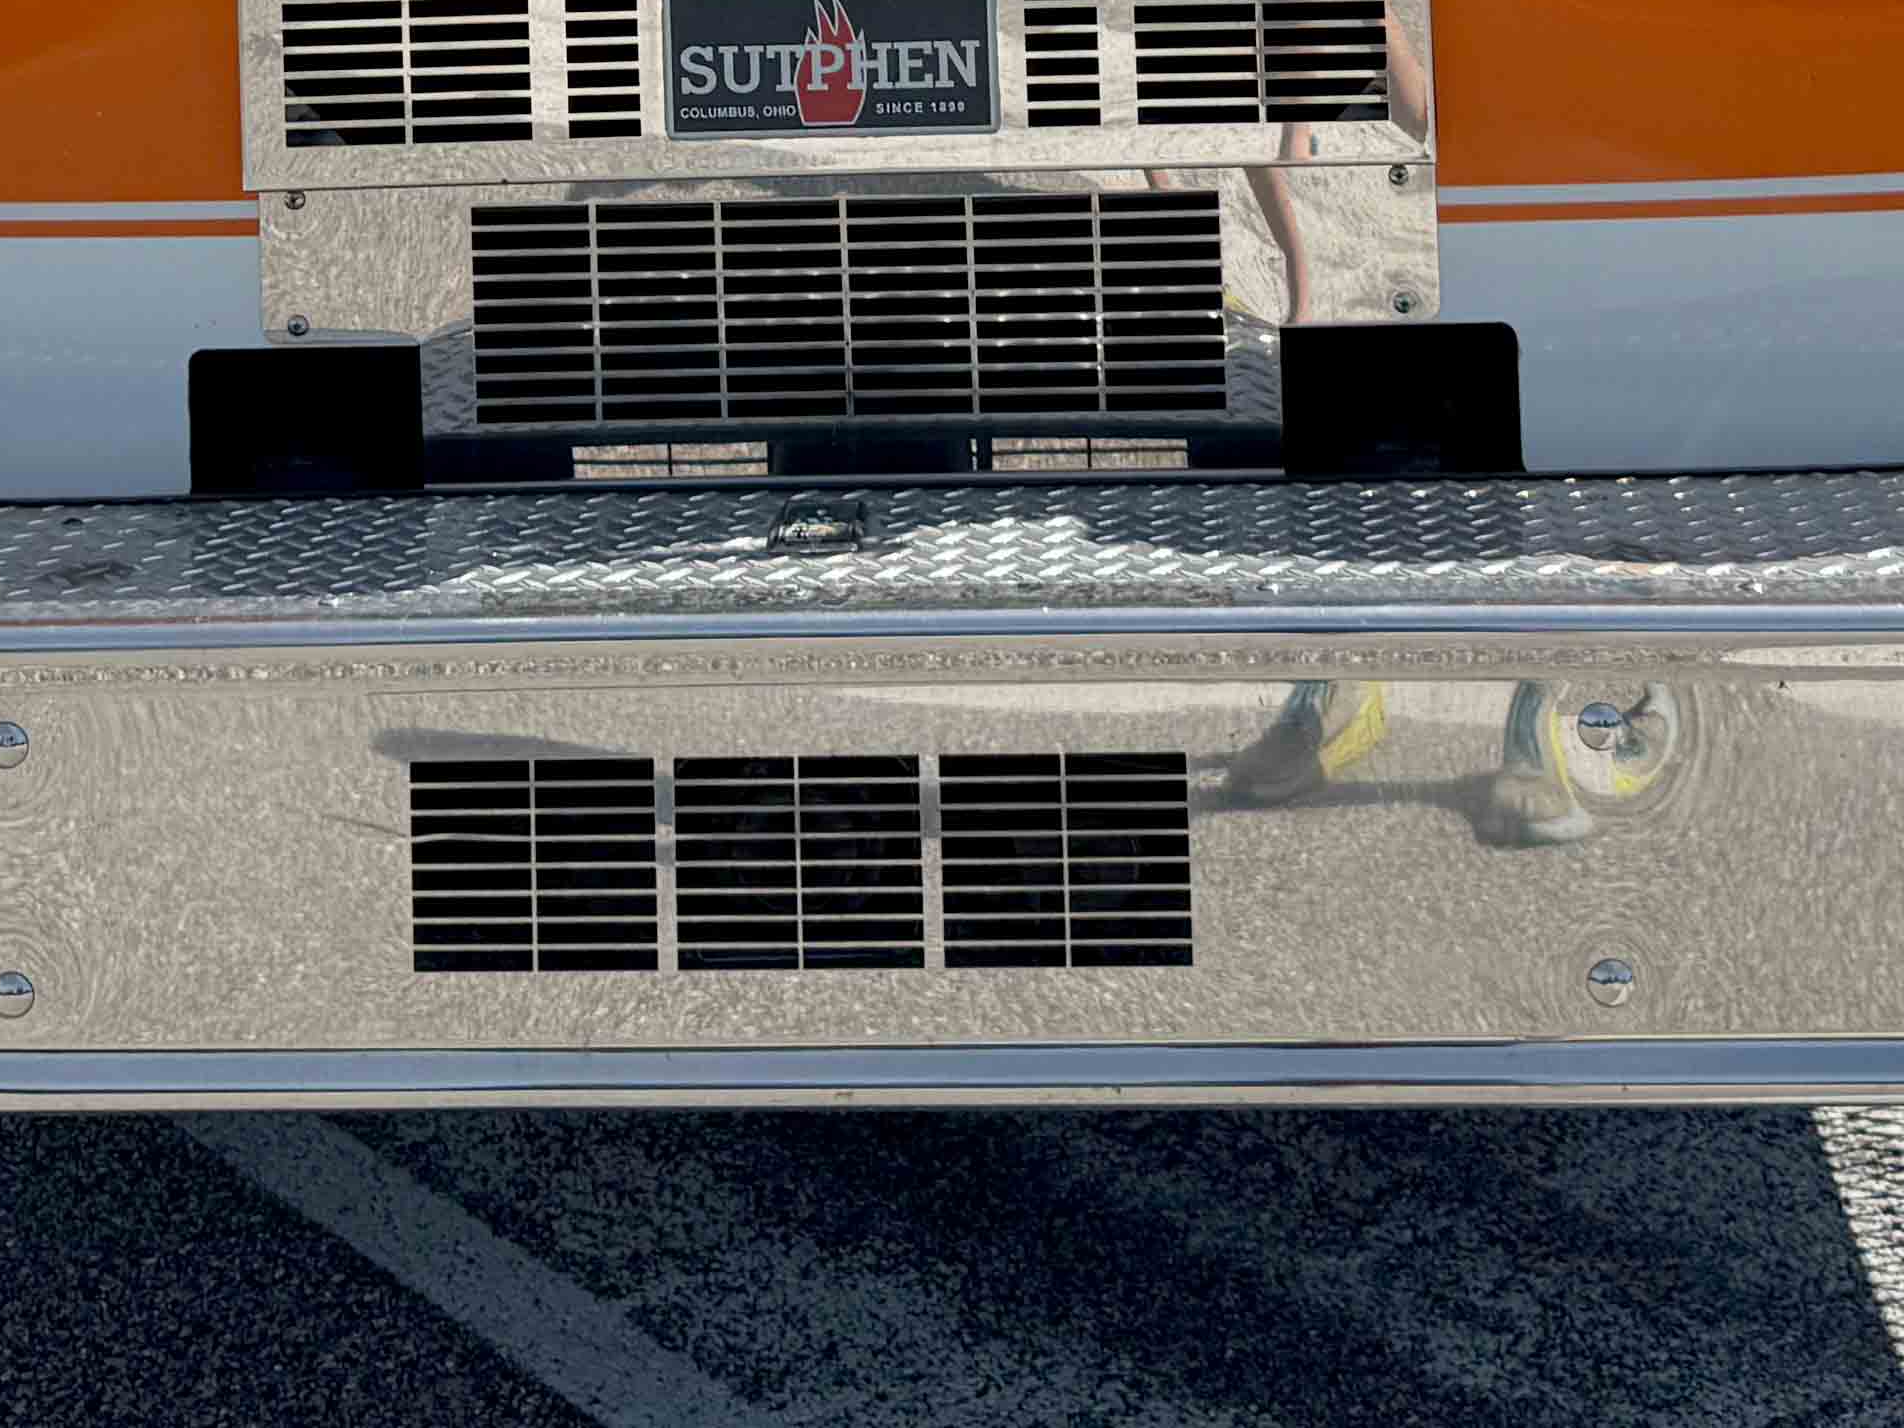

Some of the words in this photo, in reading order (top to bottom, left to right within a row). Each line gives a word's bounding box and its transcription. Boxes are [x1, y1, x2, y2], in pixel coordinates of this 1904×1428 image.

[680, 40, 980, 95] SUTPHEN
[680, 106, 760, 120] COLUMBUS,
[762, 104, 797, 118] OHIO
[876, 101, 924, 115] SINCE
